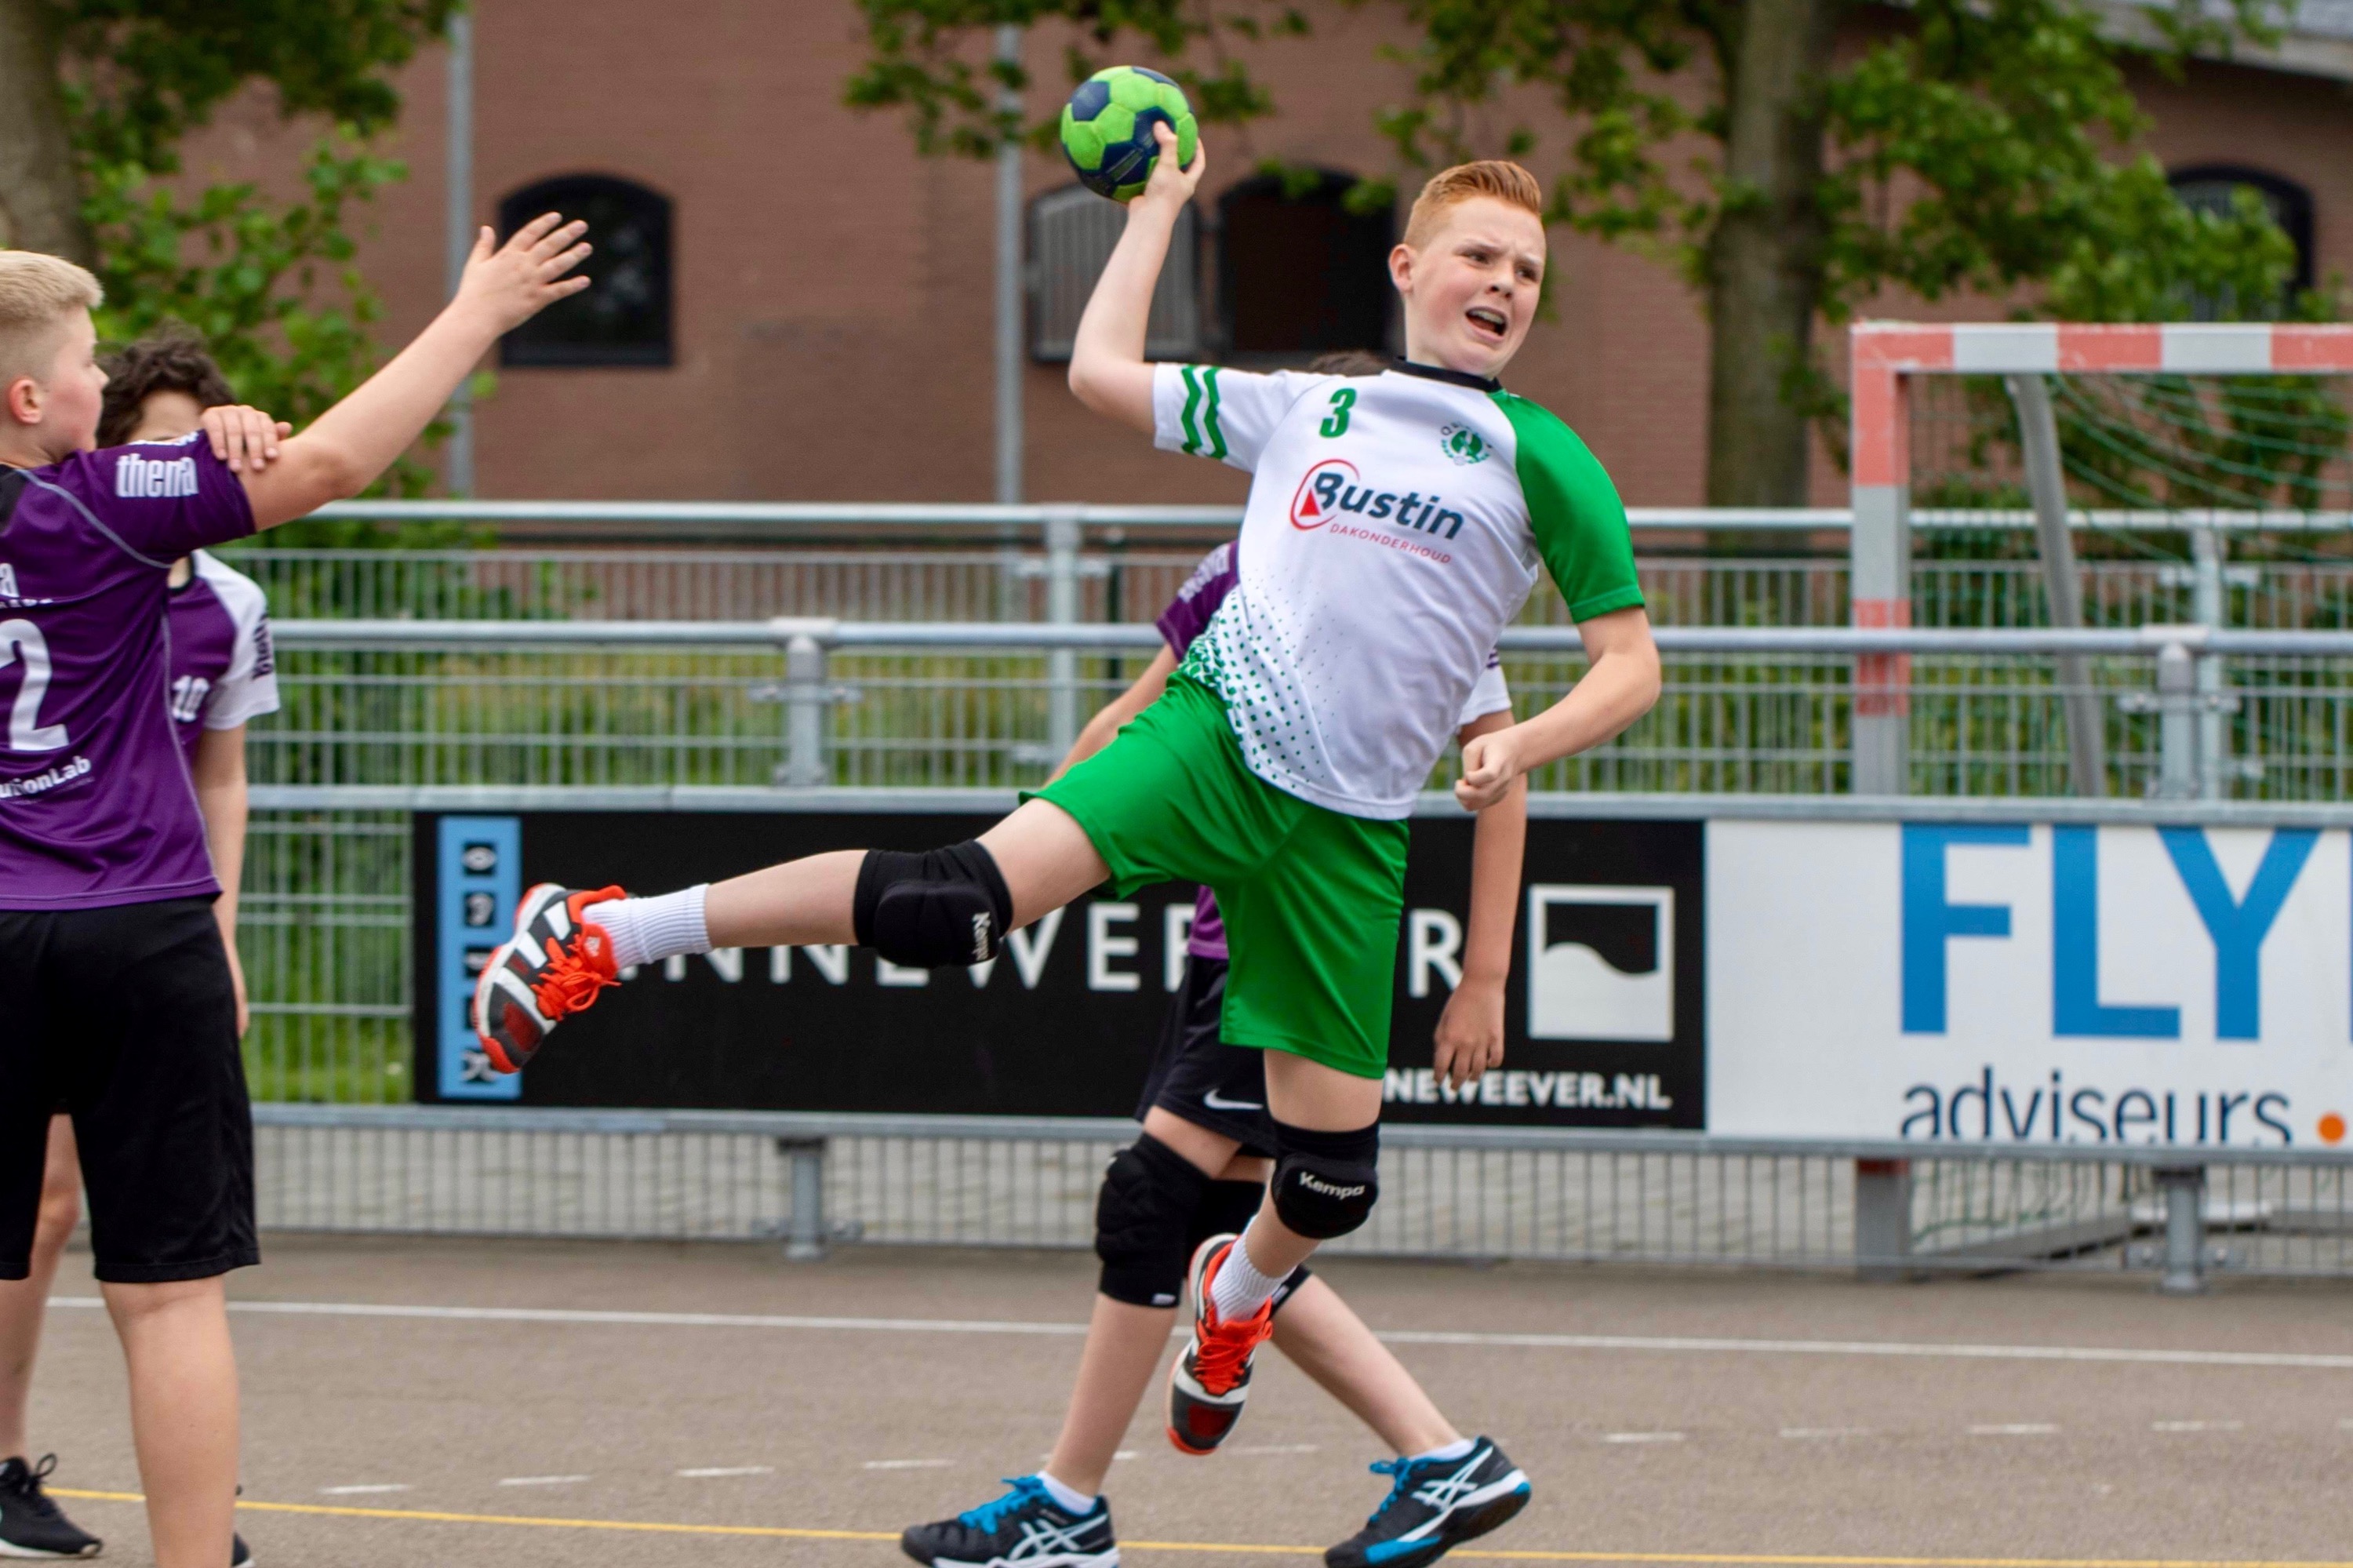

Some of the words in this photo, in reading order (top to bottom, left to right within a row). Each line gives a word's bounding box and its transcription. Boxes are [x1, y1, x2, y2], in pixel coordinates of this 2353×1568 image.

[1319, 387, 1357, 438] 3
[1313, 472, 1464, 540] Bustin
[1329, 523, 1452, 564] DAKONDERHOUD
[0, 618, 69, 751] 2
[1900, 822, 2353, 1043] FLY
[1383, 1068, 1673, 1111] NEWEEVER.NL
[1900, 1064, 2293, 1144] adviseurs
[1299, 1171, 1366, 1201] Kempa
